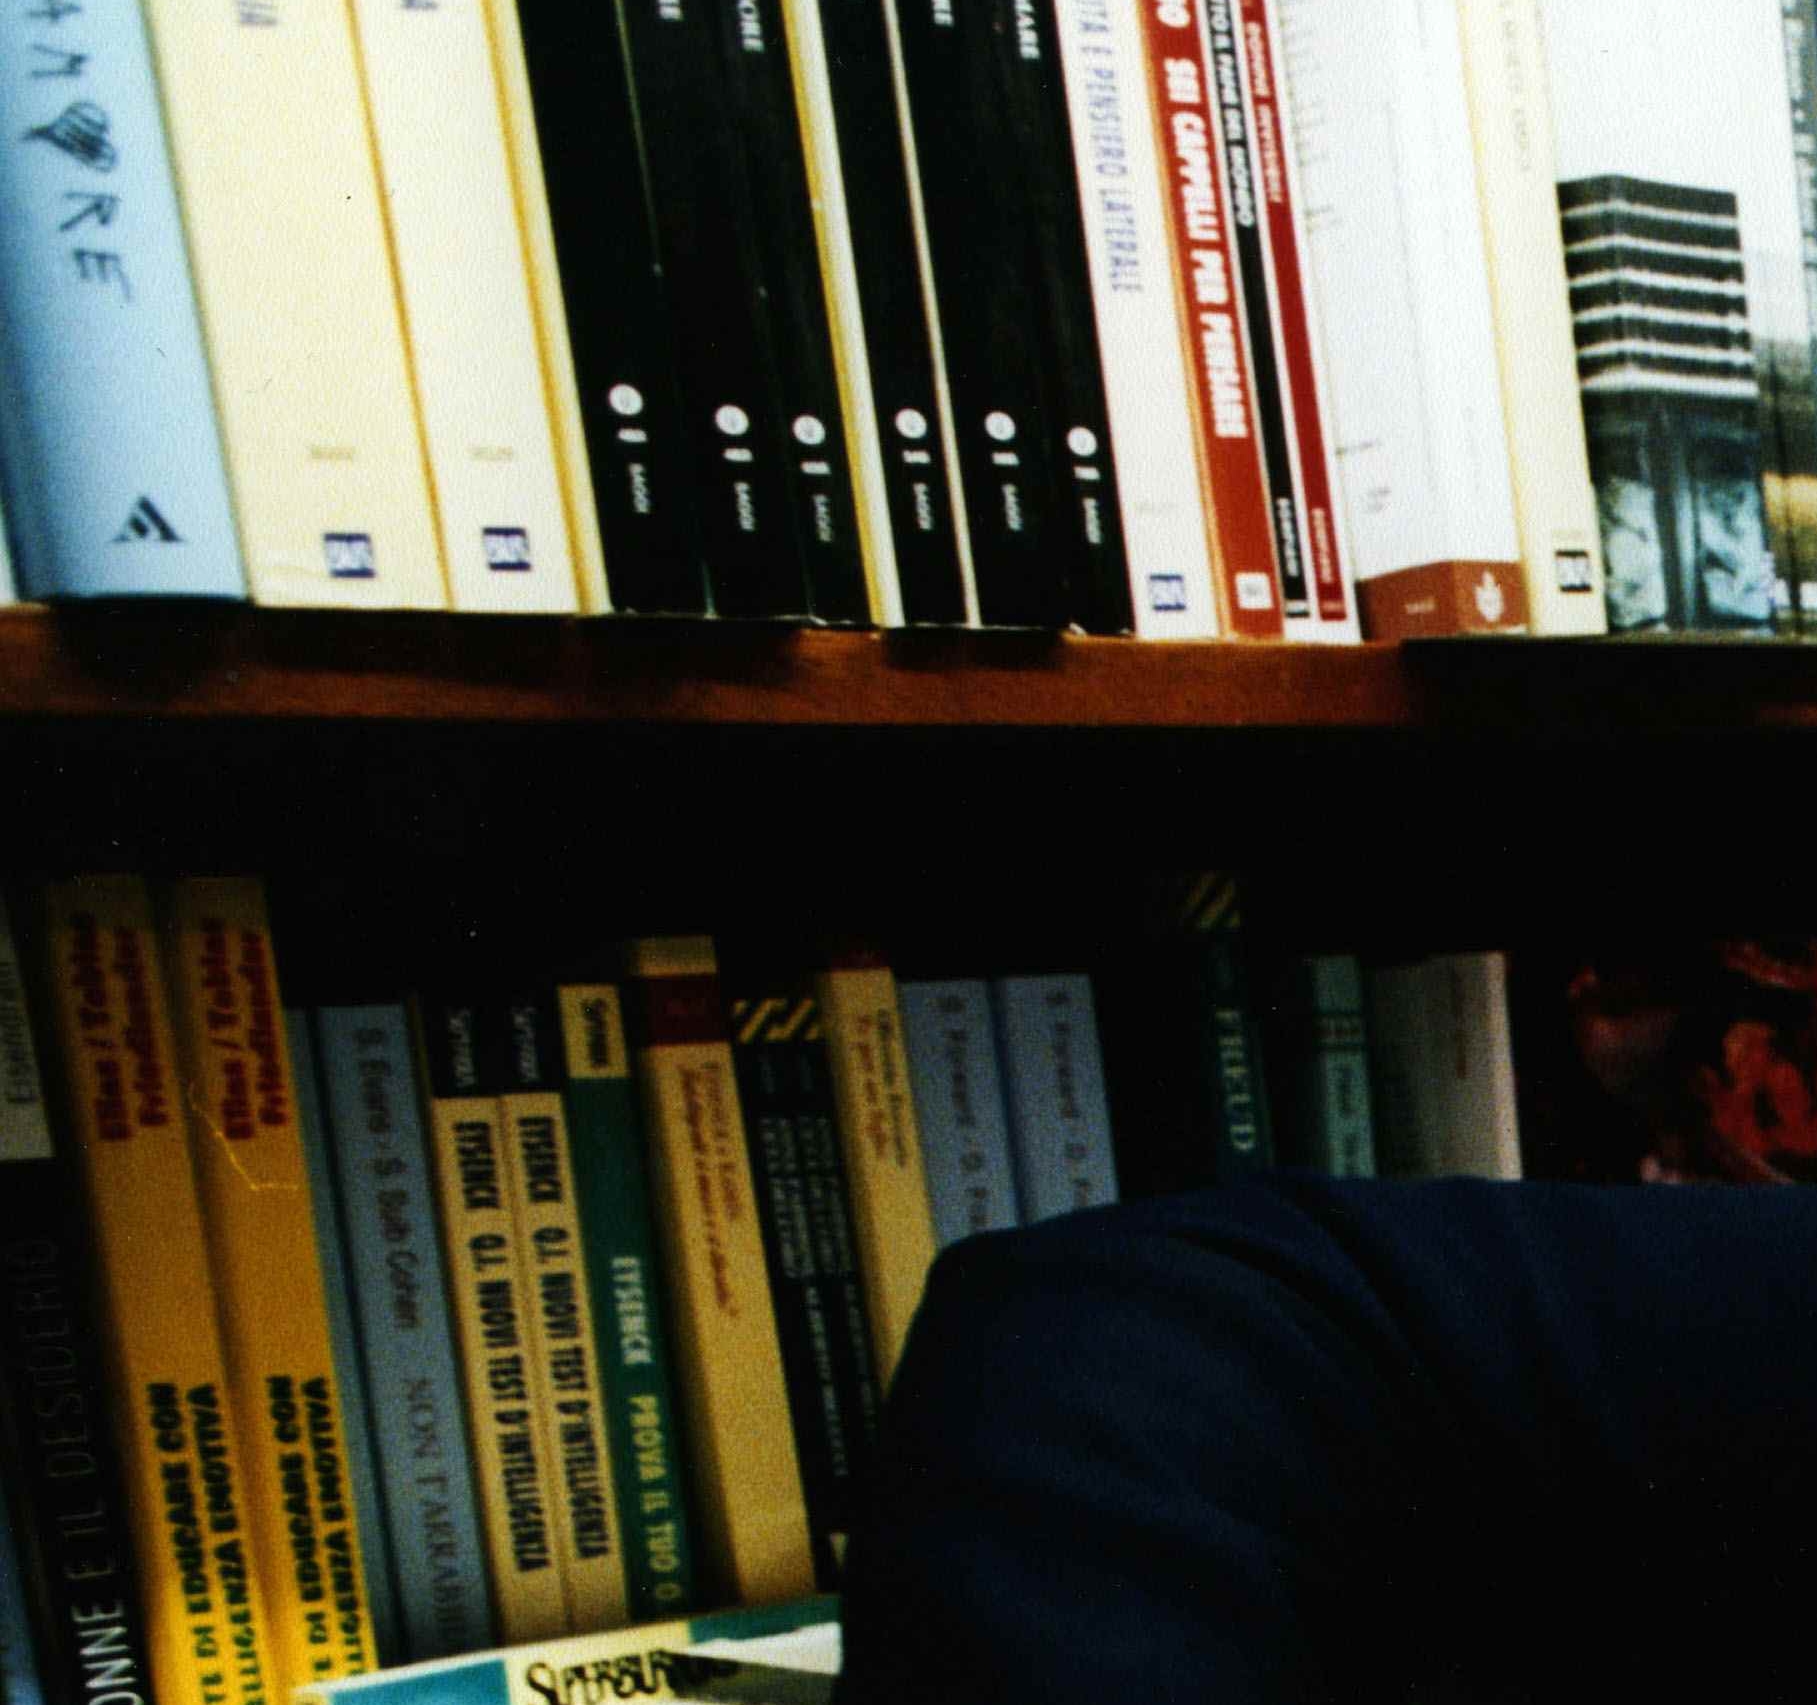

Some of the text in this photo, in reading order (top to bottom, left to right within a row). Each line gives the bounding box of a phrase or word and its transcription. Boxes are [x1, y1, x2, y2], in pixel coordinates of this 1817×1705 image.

[1083, 64, 1129, 179] PENSIERO
[1159, 53, 1203, 108] SEI
[1167, 107, 1224, 246] CAPPELLI
[1098, 184, 1144, 294] LATERALE
[1188, 244, 1233, 307] PER
[1197, 305, 1253, 436] PENSARE
[1212, 1005, 1257, 1153] FREUD
[25, 1233, 99, 1479] DESIDERIO
[452, 1116, 551, 1575] EYSENCK Q.I. NUOVI TEST D'INTELLIGENZA
[517, 1111, 610, 1561] EYSENCK Q.I. NUOVI TEST D'INTELLIGENZA
[607, 1254, 652, 1370] EYSENCK
[141, 1378, 188, 1454] CON
[182, 1379, 244, 1533] EMOTIVA
[296, 1371, 351, 1524] EMOTIVA
[401, 1372, 443, 1456] NON
[625, 1393, 668, 1485] PROVA
[52, 1501, 110, 1539] IL
[157, 1461, 219, 1616] EDUCARE
[263, 1370, 336, 1646] DI EDUCARE CON
[639, 1491, 672, 1517] IL
[643, 1521, 681, 1577] TUO
[62, 1554, 118, 1583] E
[187, 1619, 228, 1662] DI
